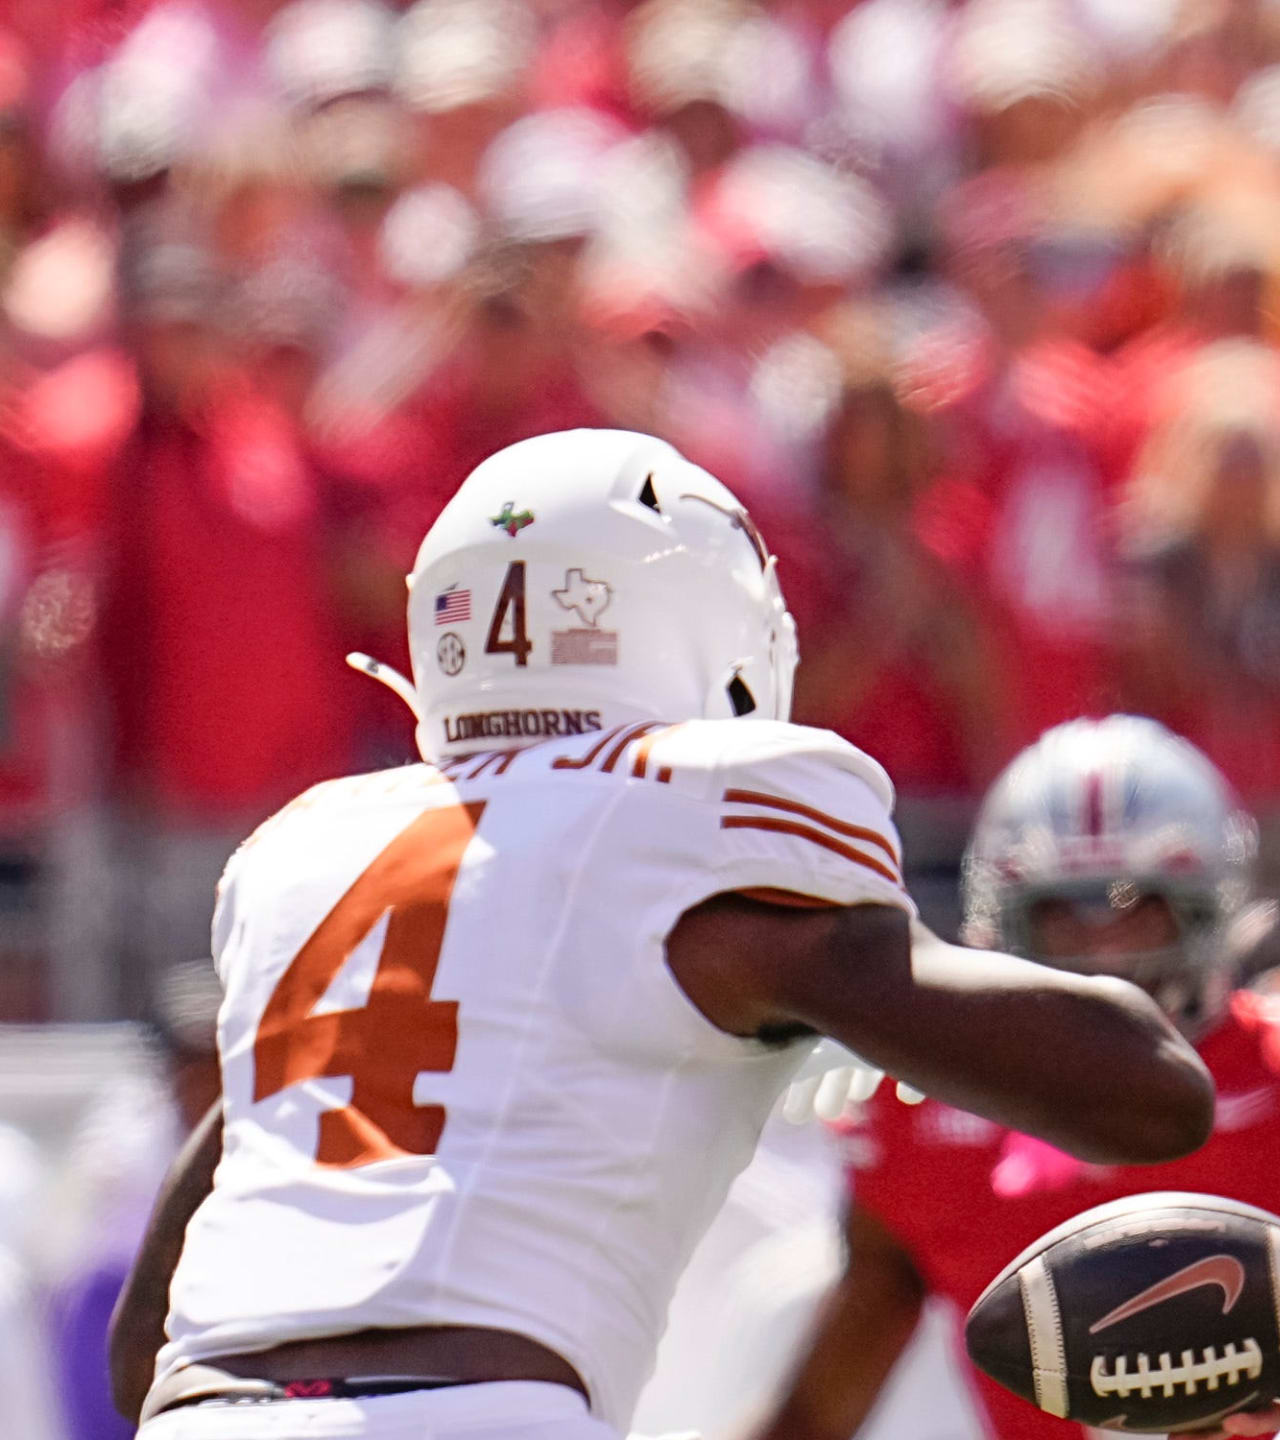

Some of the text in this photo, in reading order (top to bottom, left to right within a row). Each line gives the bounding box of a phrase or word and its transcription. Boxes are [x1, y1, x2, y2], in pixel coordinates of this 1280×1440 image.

[484, 560, 532, 668] 4
[444, 708, 602, 743] LONGHORNS
[253, 799, 488, 1170] 4
